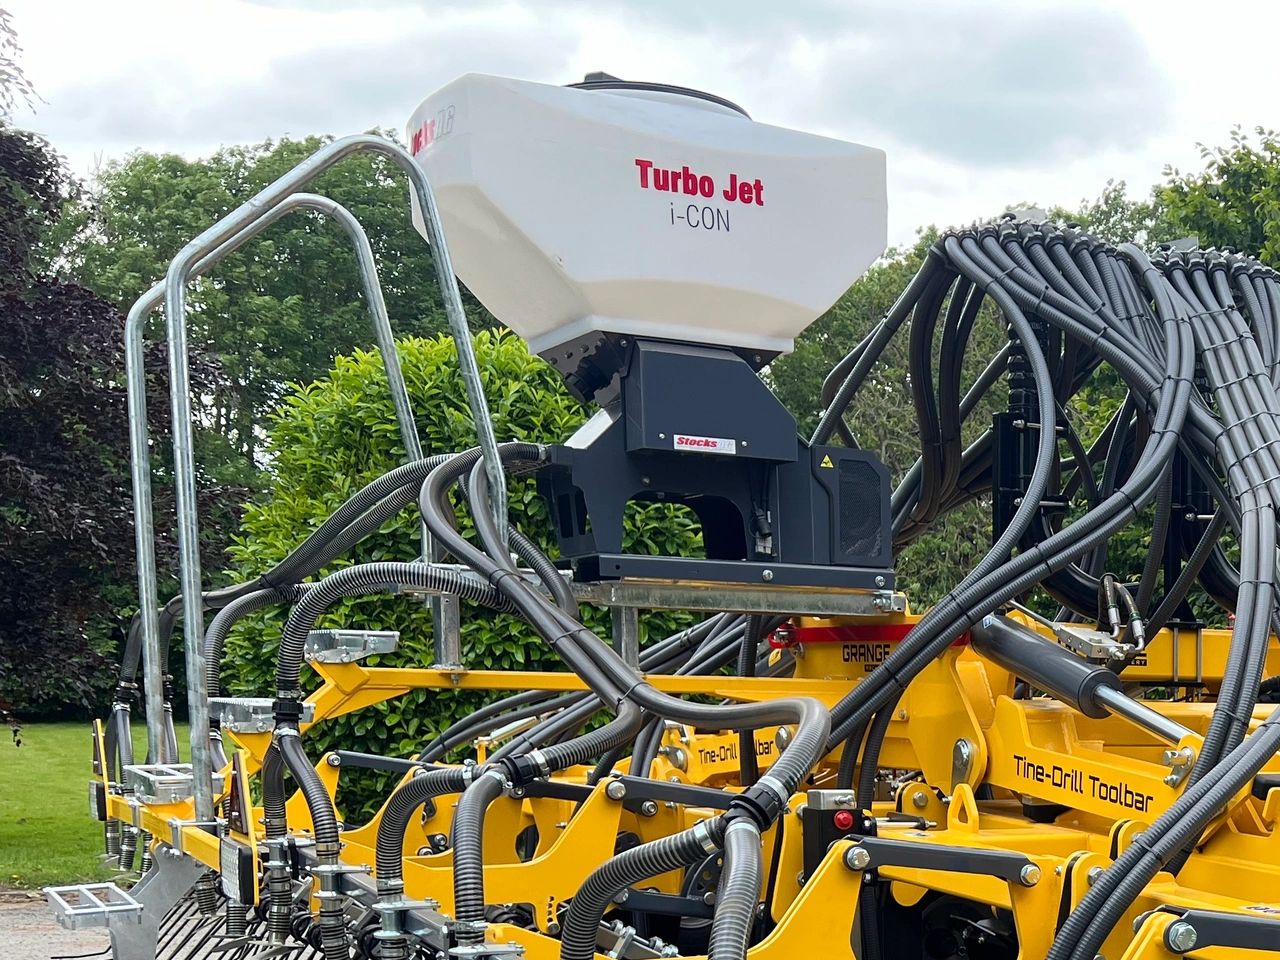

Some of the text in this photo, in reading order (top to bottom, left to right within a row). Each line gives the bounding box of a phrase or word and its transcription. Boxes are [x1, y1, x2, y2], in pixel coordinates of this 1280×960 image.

[635, 158, 764, 206] Turbo Jet
[670, 202, 730, 232] i-CON
[676, 436, 718, 448] Stocks
[842, 644, 891, 663] GRANGE
[698, 743, 738, 765] Tine-Drill
[1013, 754, 1154, 813] Tine-Drill Toolbar
